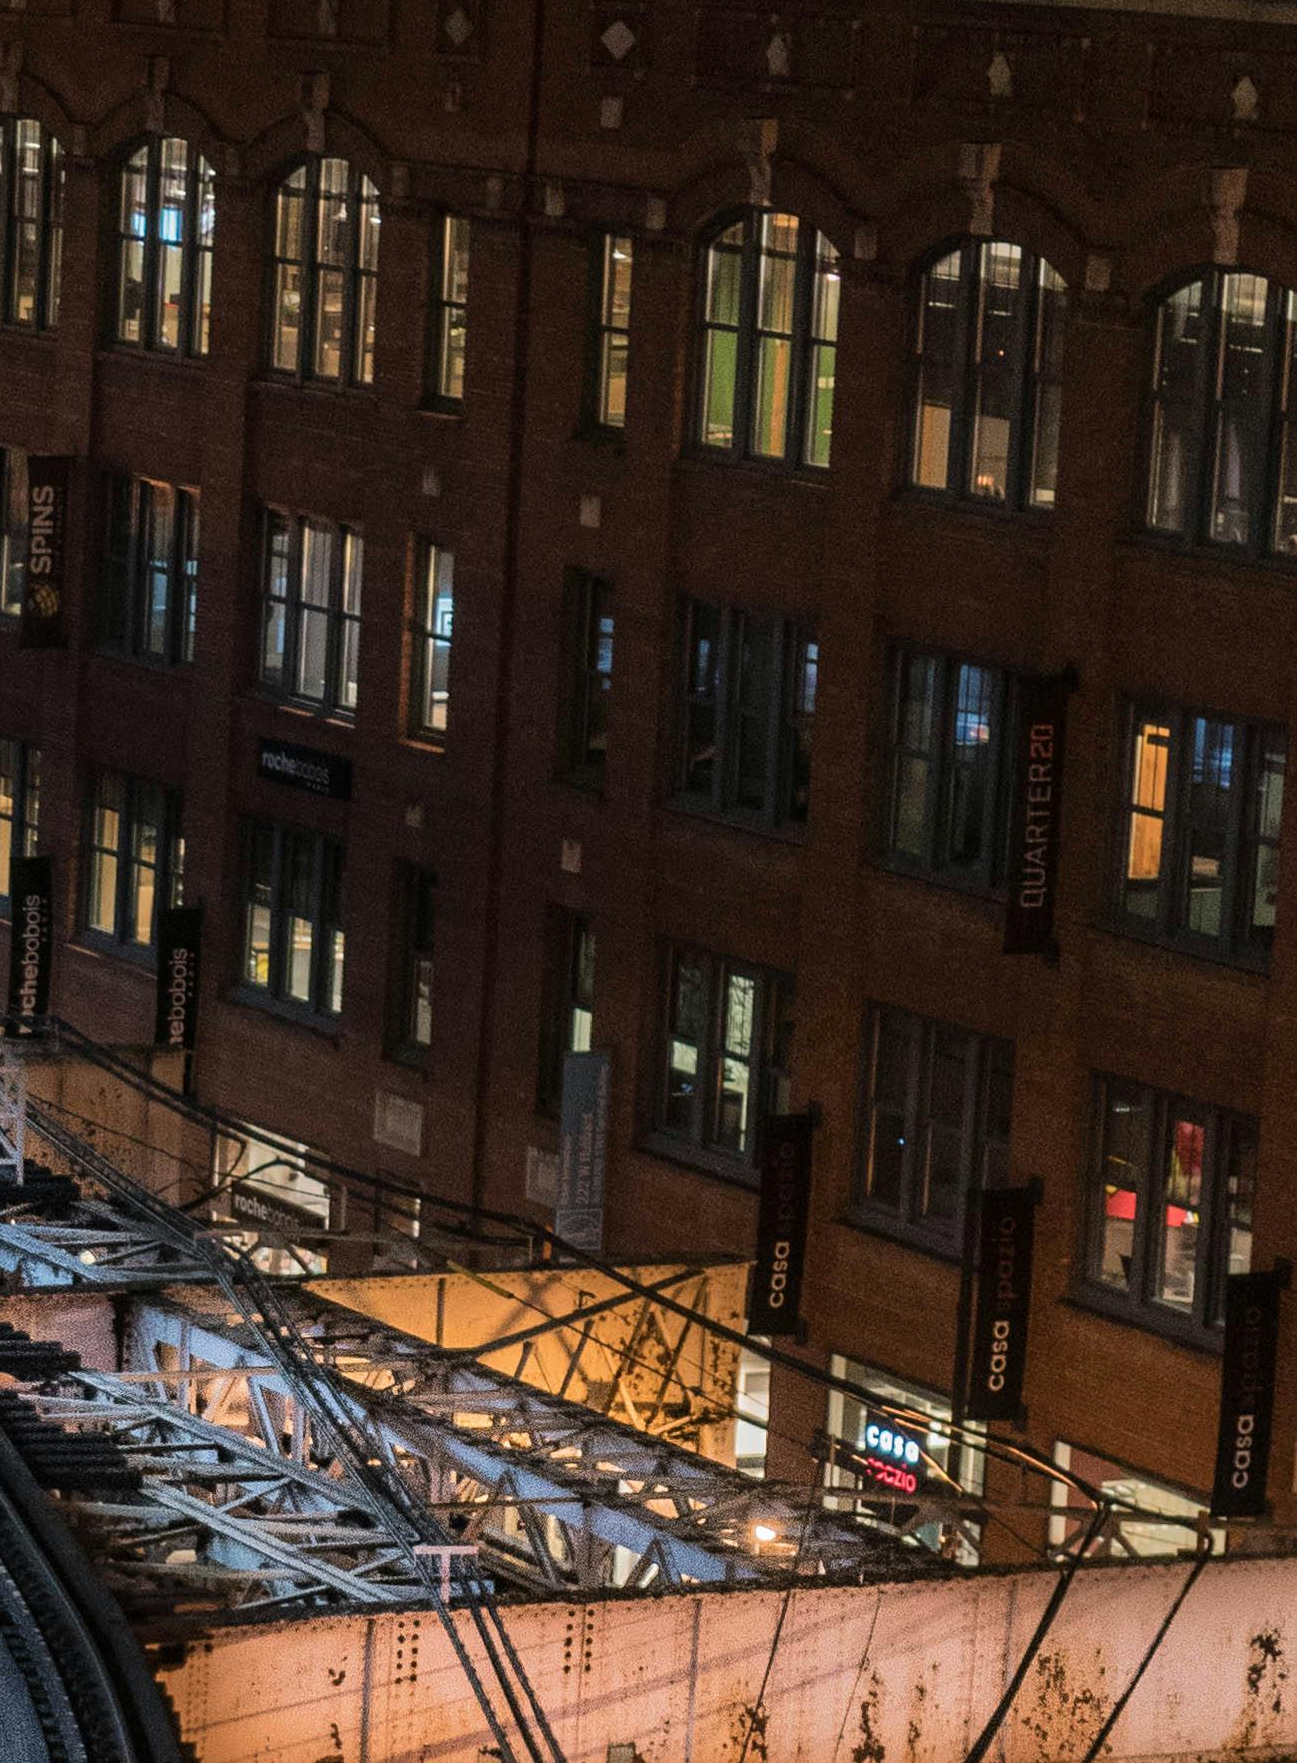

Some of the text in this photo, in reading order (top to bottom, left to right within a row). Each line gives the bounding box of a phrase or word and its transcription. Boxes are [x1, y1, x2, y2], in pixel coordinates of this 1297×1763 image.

[30, 484, 54, 574] SPINS
[768, 1241, 791, 1309] casa
[987, 1320, 1011, 1393] casa
[866, 1424, 920, 1463] casa
[1231, 1414, 1255, 1490] casa
